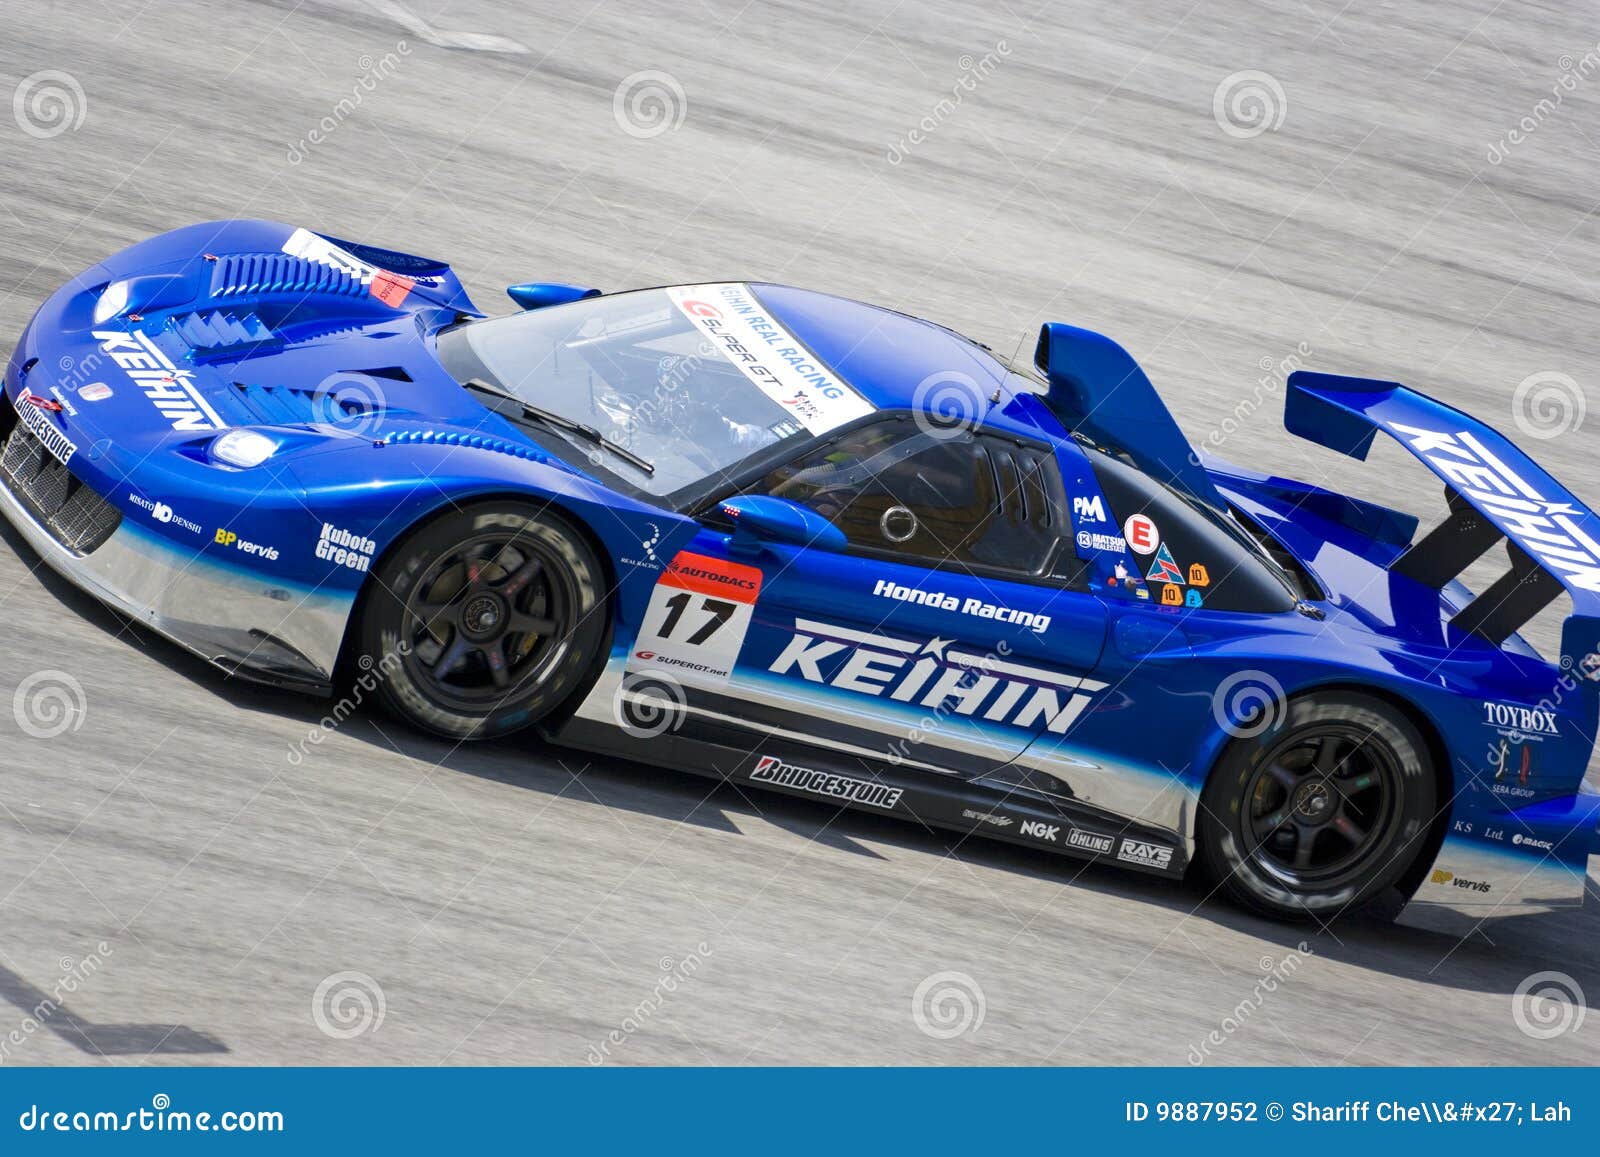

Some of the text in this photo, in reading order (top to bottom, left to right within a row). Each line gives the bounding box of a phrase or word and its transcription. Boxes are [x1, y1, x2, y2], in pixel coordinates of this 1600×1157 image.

[701, 318, 784, 388] SUPER GT
[745, 315, 780, 346] REAL
[776, 346, 845, 400] RACING
[91, 330, 222, 431] KEIHIN
[1073, 495, 1107, 522] PM
[172, 514, 202, 534] DENSHI
[1132, 519, 1151, 548] E
[215, 528, 279, 561] BP vervis
[320, 522, 376, 555] Kubota
[1092, 533, 1126, 547] MATSUO
[314, 539, 370, 573] Green
[679, 566, 756, 590] AUTOBACS
[1191, 569, 1202, 582] 10
[873, 579, 1052, 634] Honda Racing
[1164, 588, 1176, 601] 10
[656, 592, 738, 646] 17
[656, 655, 728, 677] SUPERGT.net
[768, 624, 1102, 734] KEIHIN
[1483, 701, 1559, 734] TOYBOX
[750, 755, 903, 808] BRIDGESTONE
[1510, 788, 1536, 798] GROUP
[1019, 819, 1062, 842] NGK
[1069, 830, 1112, 853] ÖHLINS
[1119, 840, 1174, 861] RAYS
[1453, 877, 1491, 893] vervis
